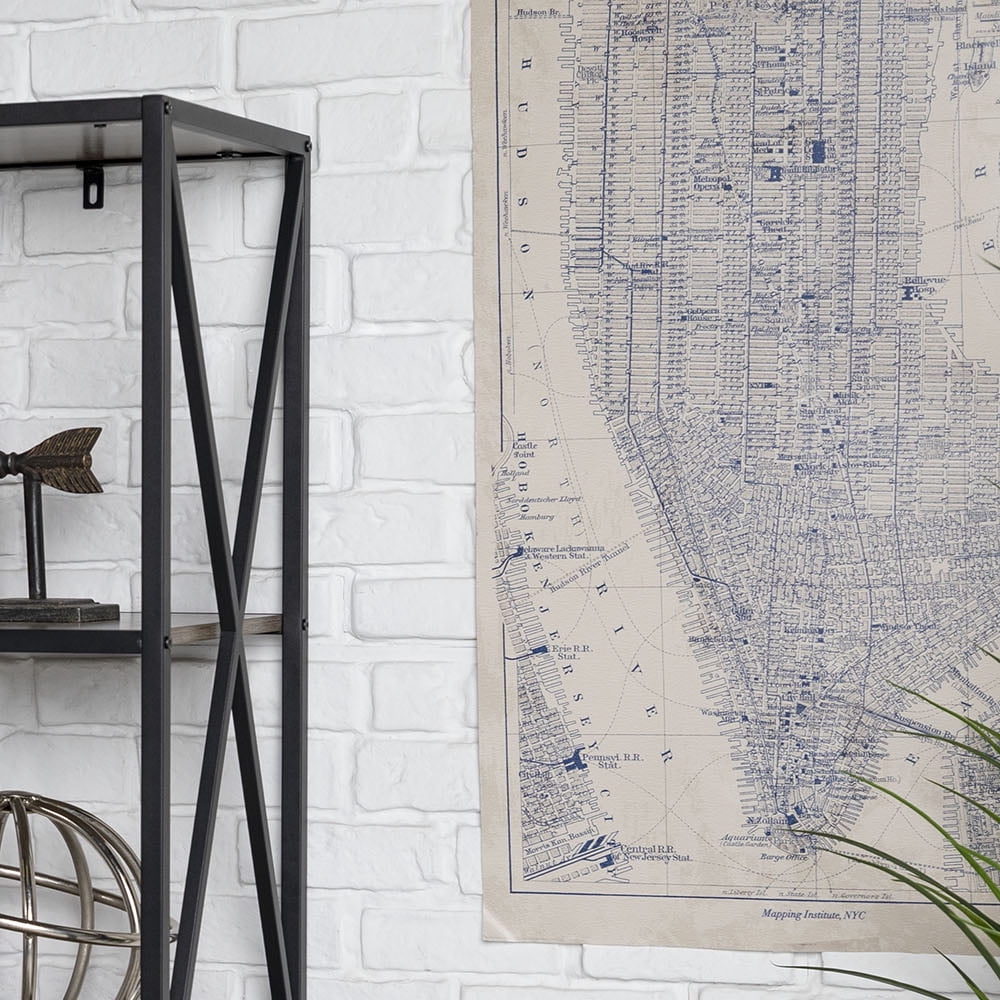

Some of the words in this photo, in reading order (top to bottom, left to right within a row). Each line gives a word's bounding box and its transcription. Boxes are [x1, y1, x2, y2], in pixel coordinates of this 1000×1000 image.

[516, 8, 548, 16] Hudson
[963, 60, 996, 71] Island
[579, 560, 602, 577] River
[720, 833, 771, 842] Aquarium
[619, 844, 656, 854] Central
[759, 853, 784, 862] Barge
[785, 853, 809, 861] Office
[761, 908, 802, 922] Mapping
[803, 909, 842, 921] Institute,
[844, 910, 867, 921] NYC
